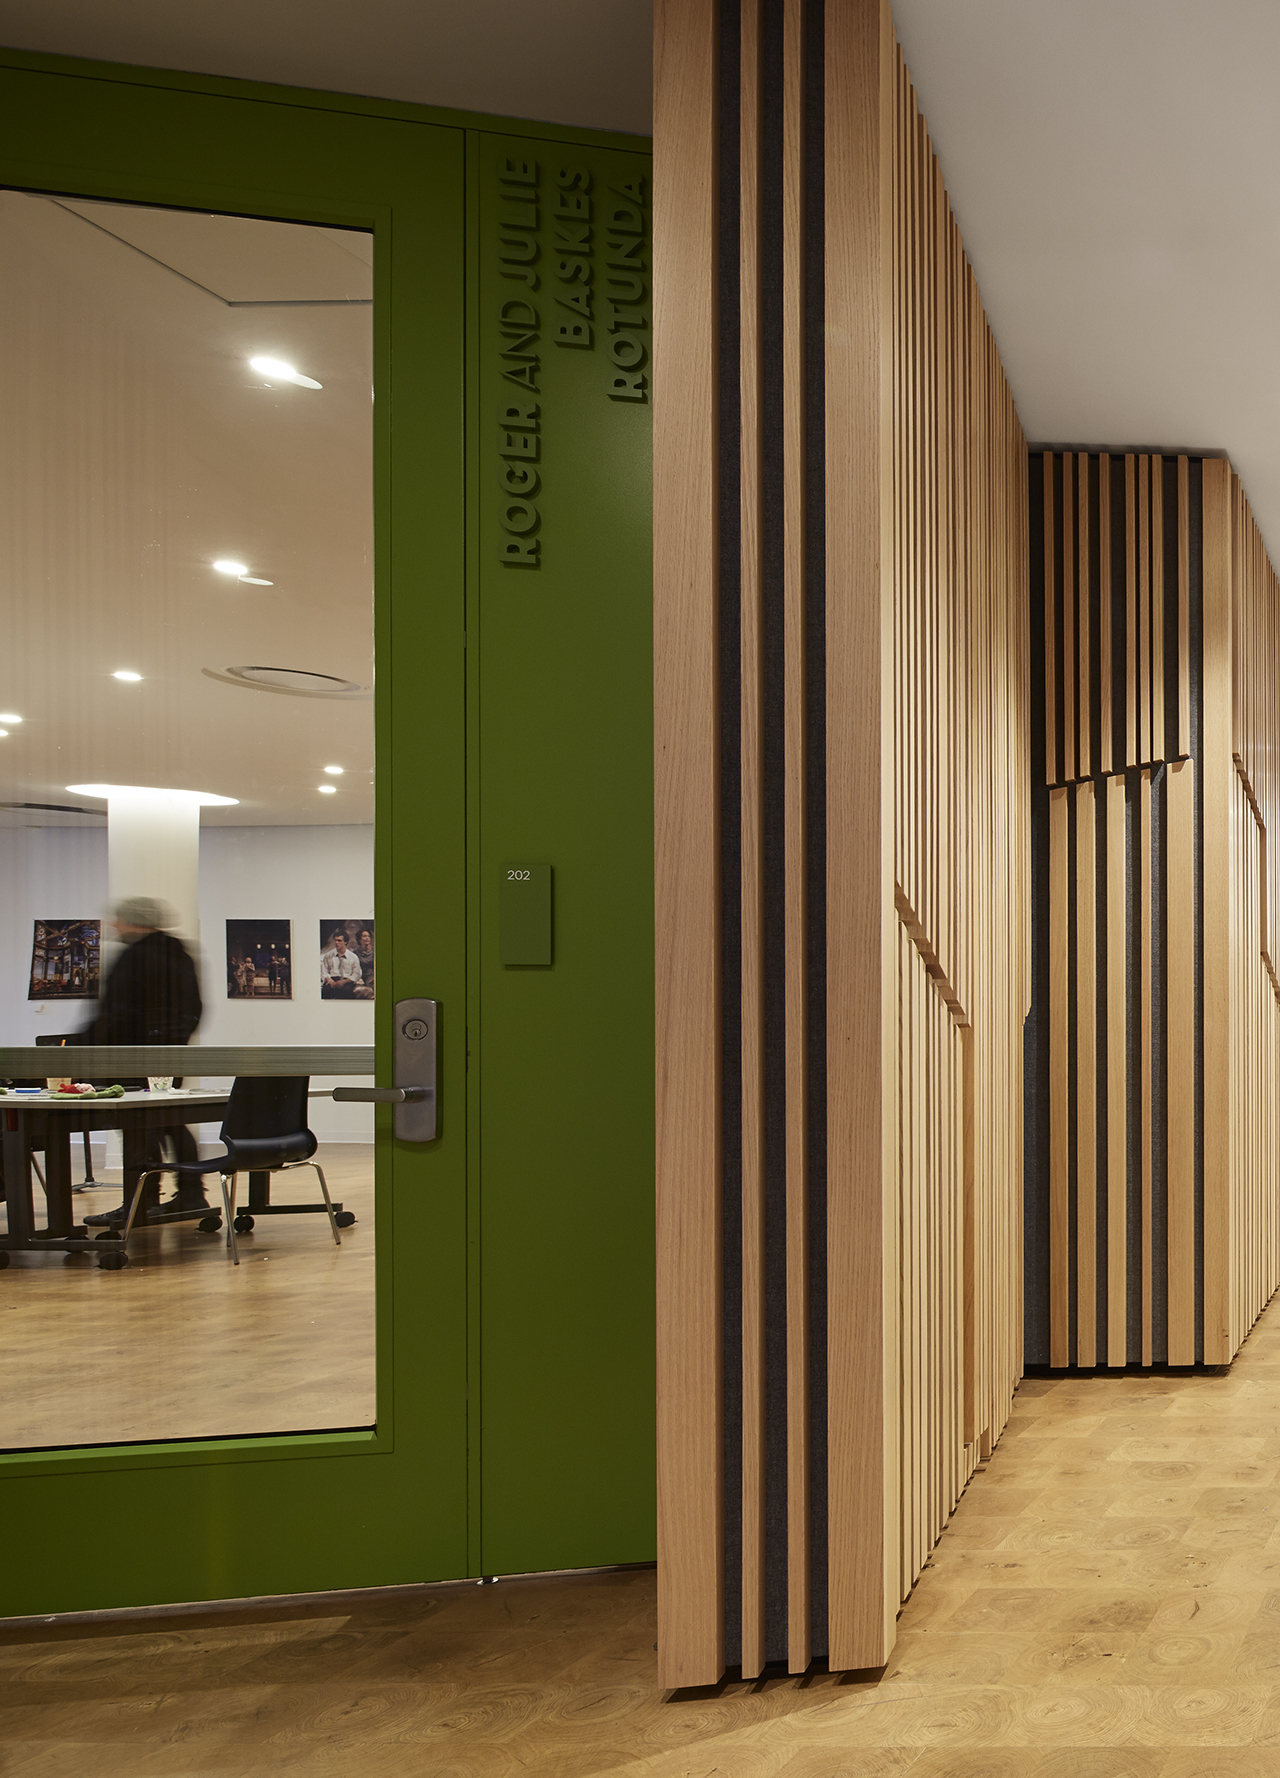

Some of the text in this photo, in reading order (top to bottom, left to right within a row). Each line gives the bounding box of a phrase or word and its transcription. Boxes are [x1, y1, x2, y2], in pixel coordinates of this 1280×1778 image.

[554, 164, 595, 351] BASKES
[607, 174, 648, 404] ROTUNDA
[501, 156, 541, 570] ROGER AND JULIE
[507, 869, 531, 881] 202
